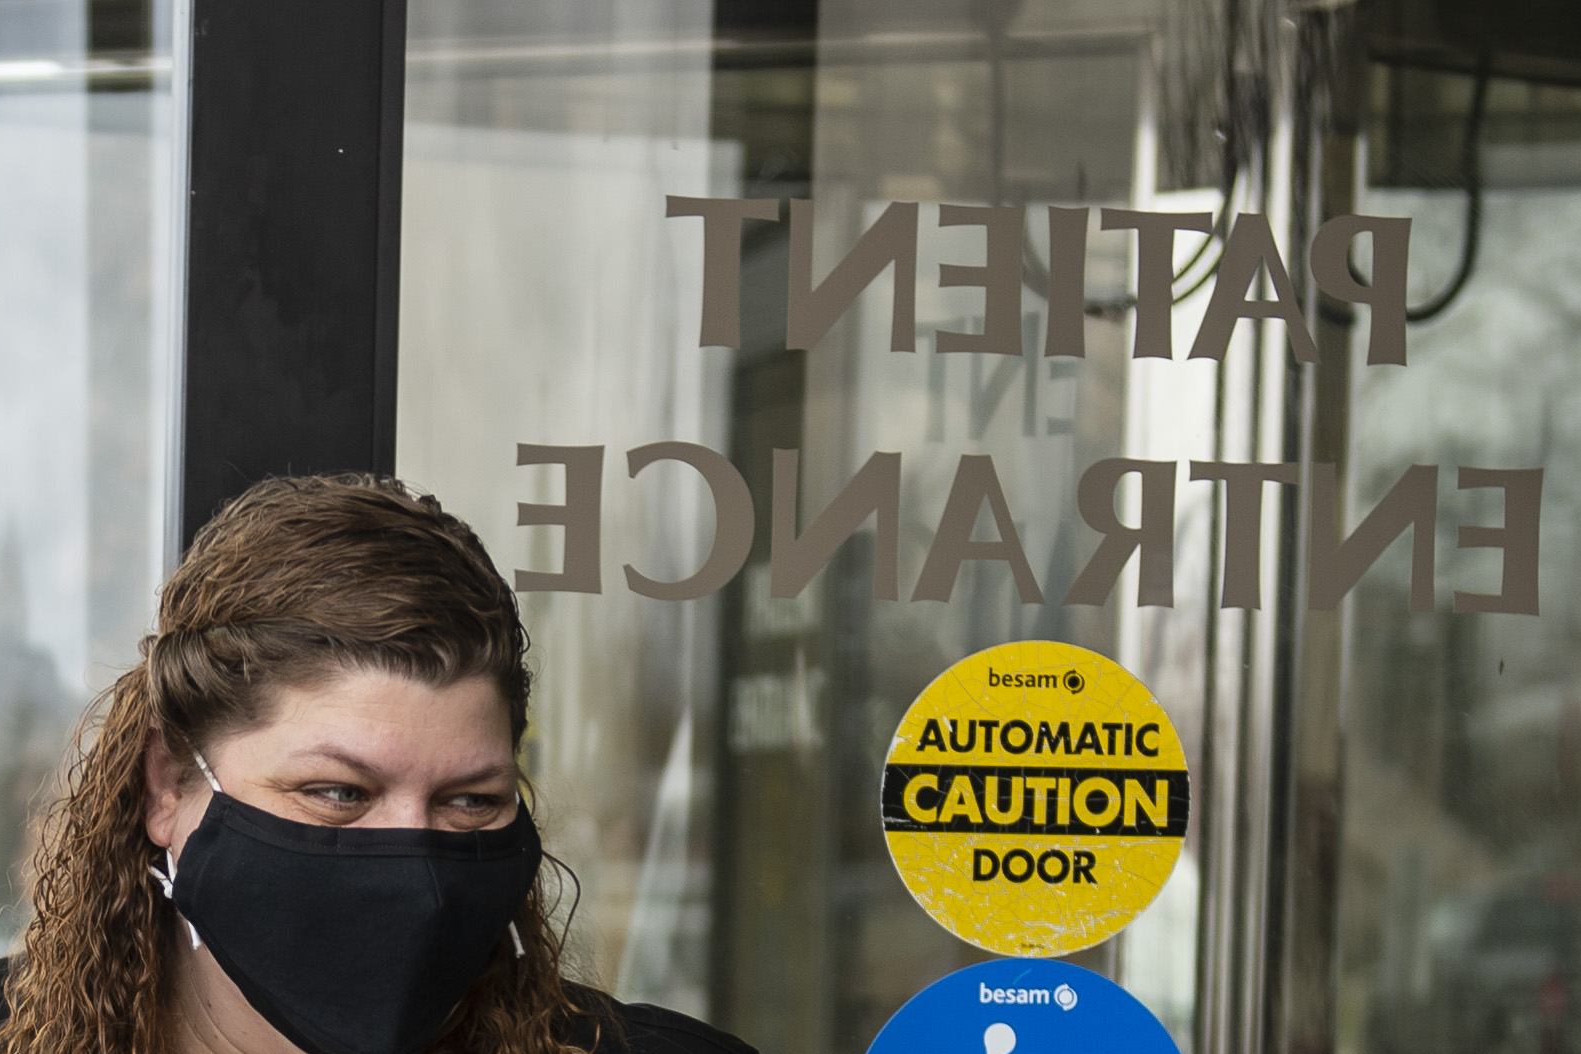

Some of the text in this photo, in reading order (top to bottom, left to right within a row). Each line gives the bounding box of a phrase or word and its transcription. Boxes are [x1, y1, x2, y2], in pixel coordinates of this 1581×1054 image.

[988, 667, 1058, 689] besam
[915, 718, 1160, 757] AUTOMATIC
[902, 773, 1169, 828] CAUTION
[971, 848, 1097, 884] DOOR
[979, 982, 1050, 1005] besam
